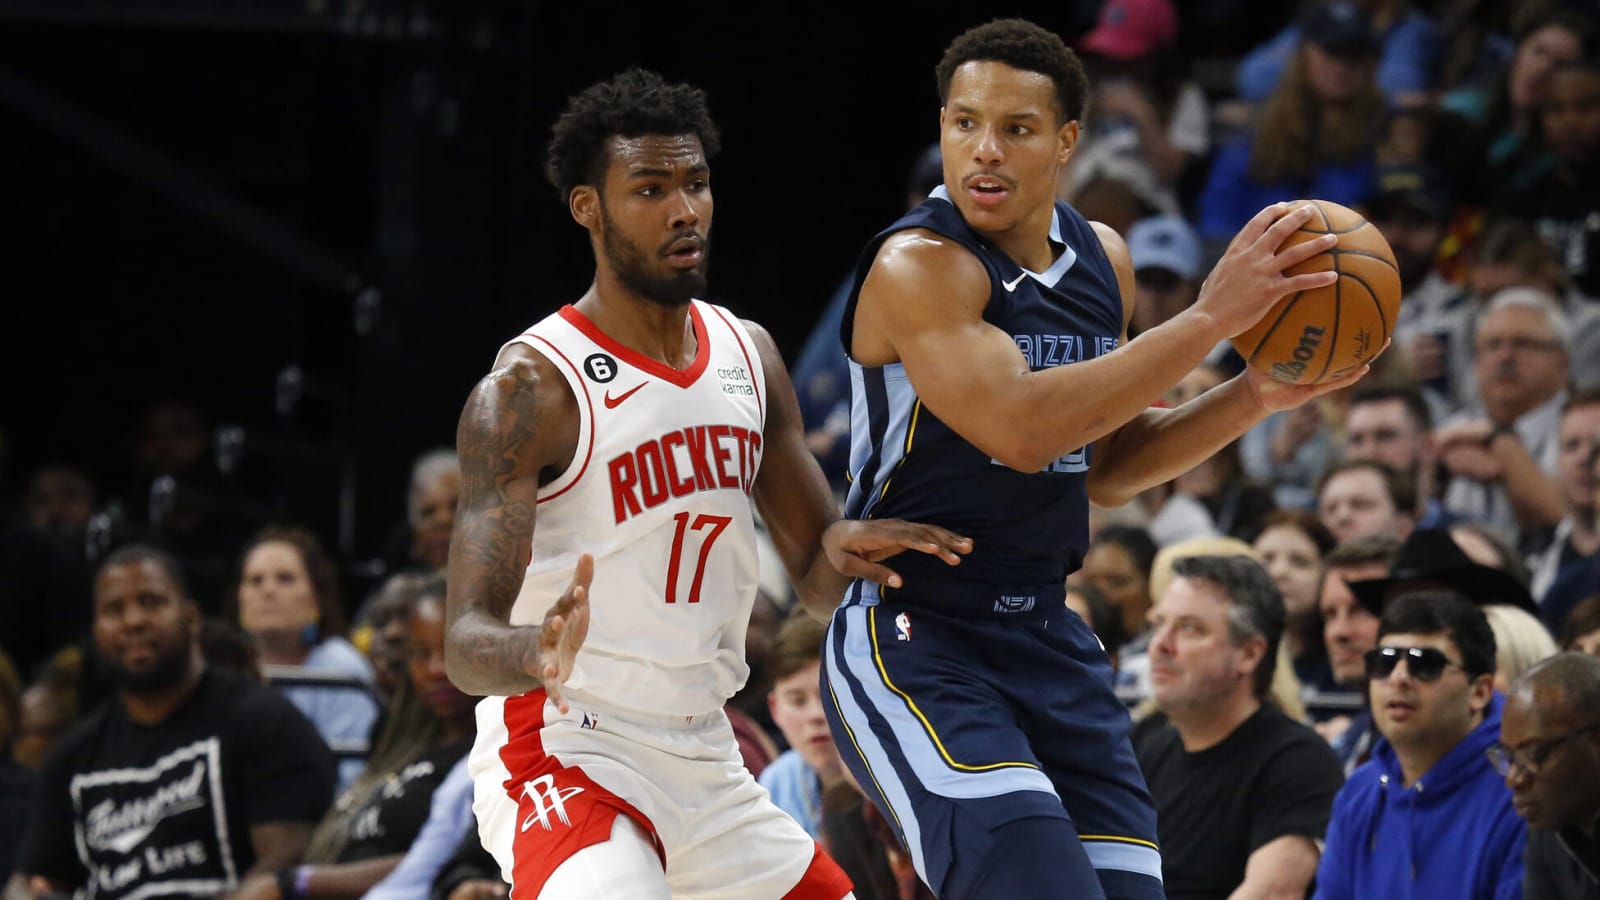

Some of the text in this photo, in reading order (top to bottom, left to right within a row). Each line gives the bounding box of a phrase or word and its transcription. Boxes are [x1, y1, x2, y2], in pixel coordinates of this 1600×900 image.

[590, 356, 612, 380] 6
[717, 365, 748, 380] credit
[720, 379, 754, 396] karma
[607, 424, 761, 525] ROCKETS
[665, 511, 733, 603] 17
